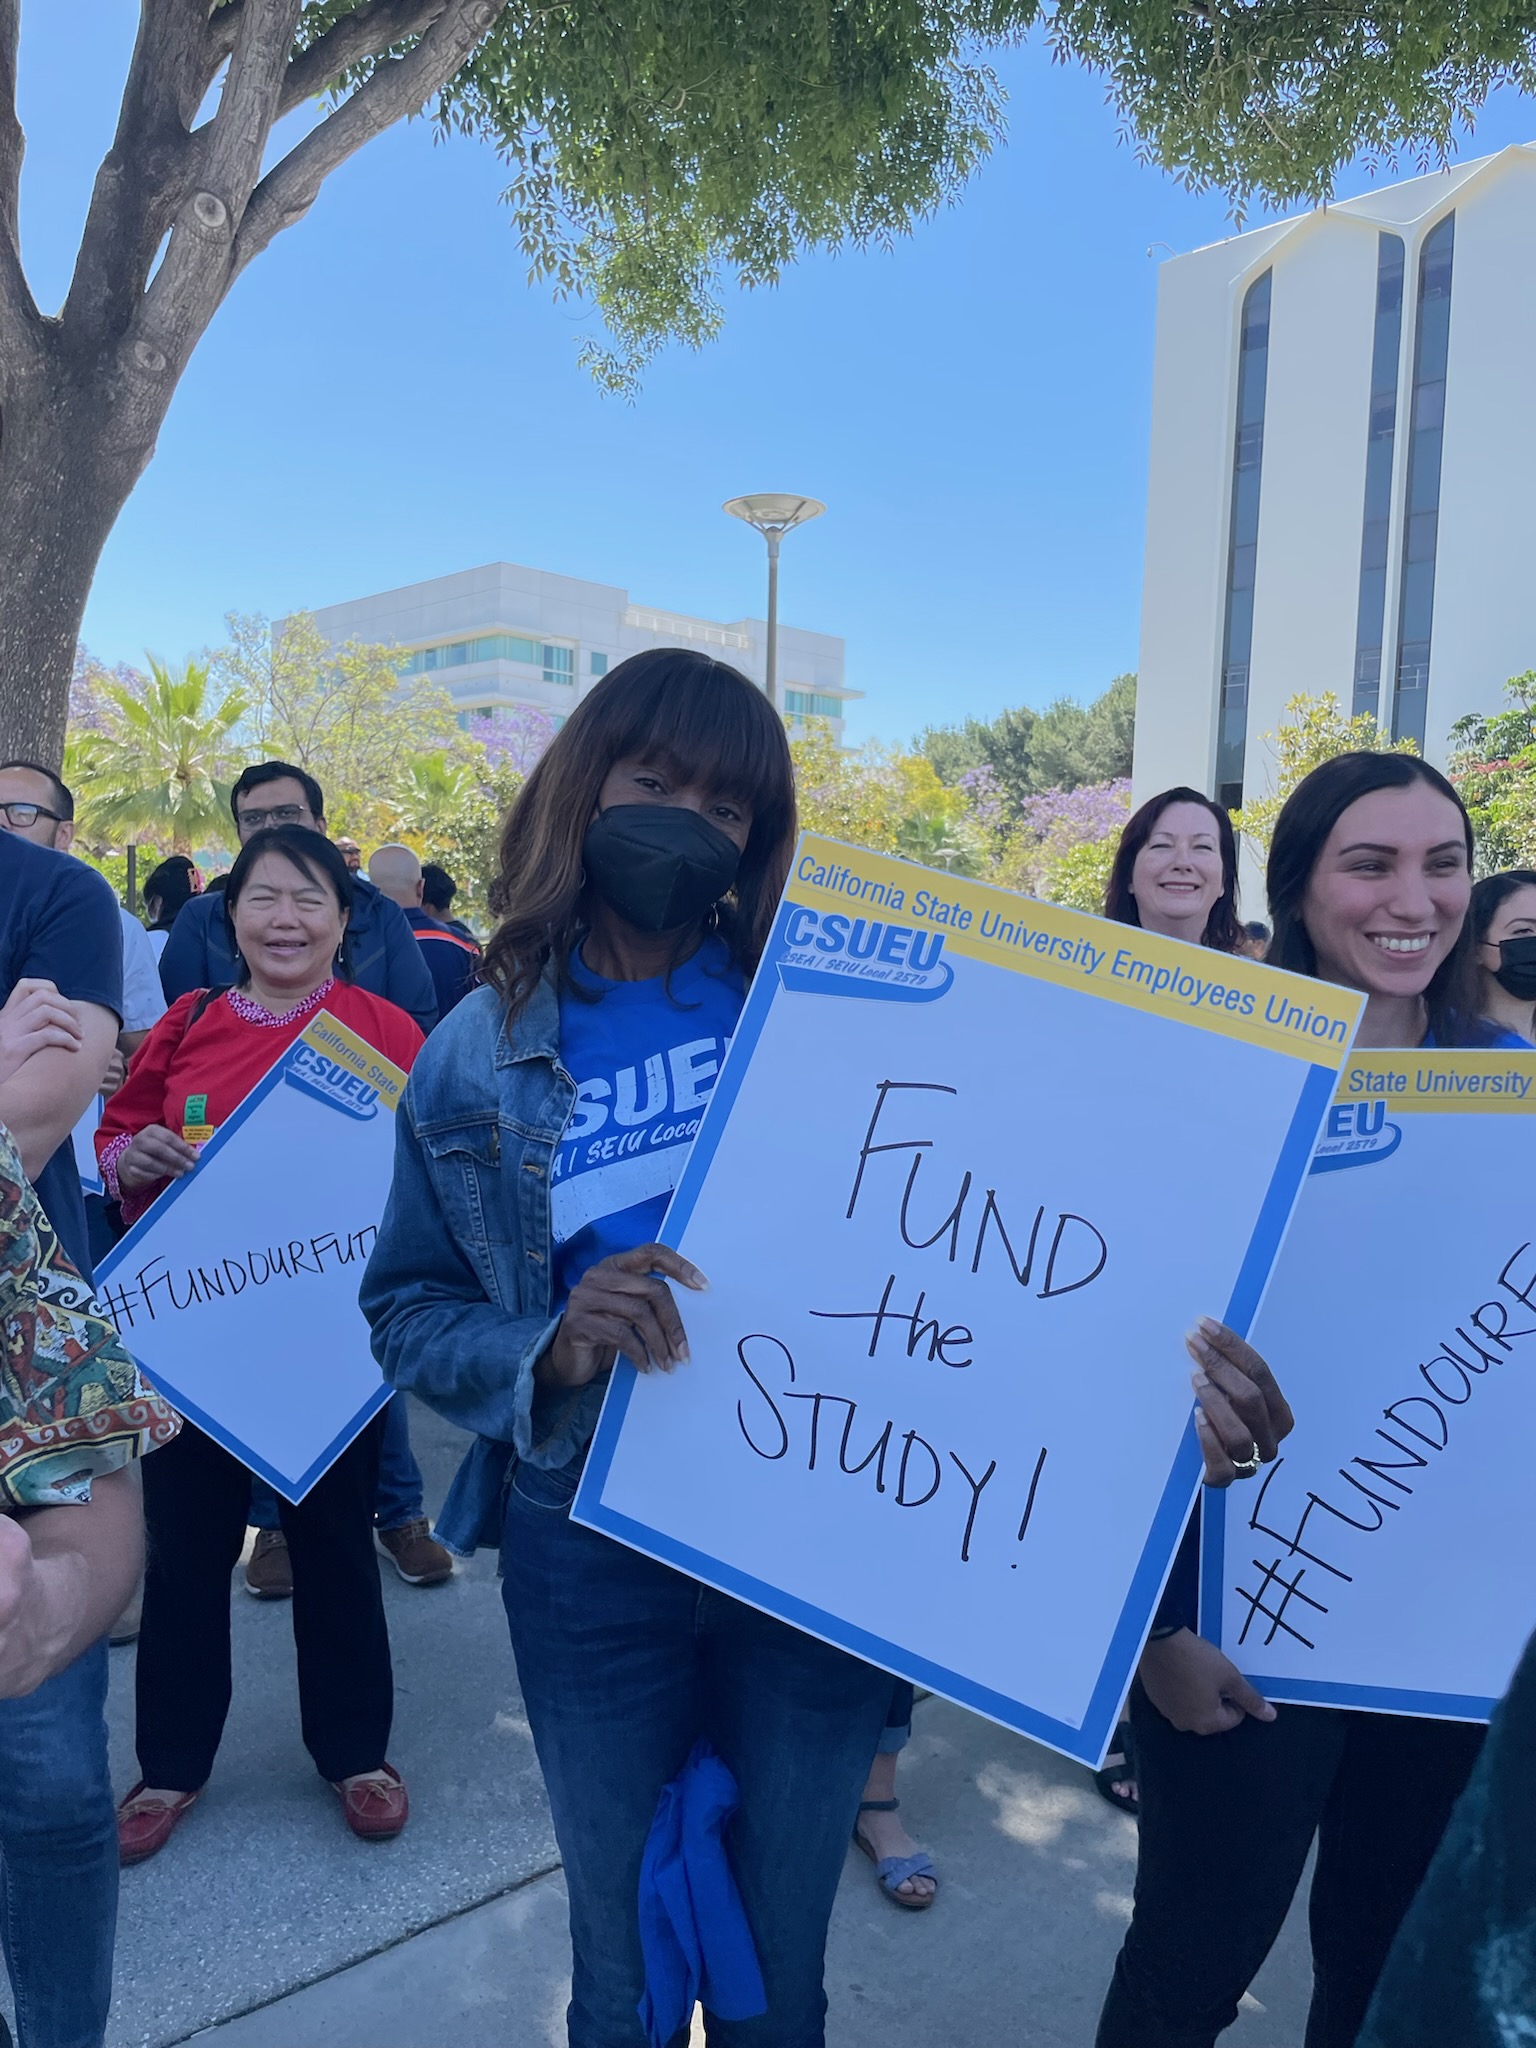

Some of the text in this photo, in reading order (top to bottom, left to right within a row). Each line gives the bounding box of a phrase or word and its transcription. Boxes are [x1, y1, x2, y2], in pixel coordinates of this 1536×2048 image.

[784, 907, 946, 972] CSUEU
[797, 854, 1347, 1043] California State University Employees Union
[860, 964, 892, 980] Local
[892, 971, 928, 986] 2579
[294, 1046, 380, 1106] CSUEU
[311, 1020, 399, 1095] California State
[1349, 1069, 1533, 1098] State University
[586, 1129, 647, 1164] SEIU
[846, 1079, 1108, 1299] FUND
[808, 1274, 974, 1368] the
[737, 1333, 1047, 1569] STUDY!
